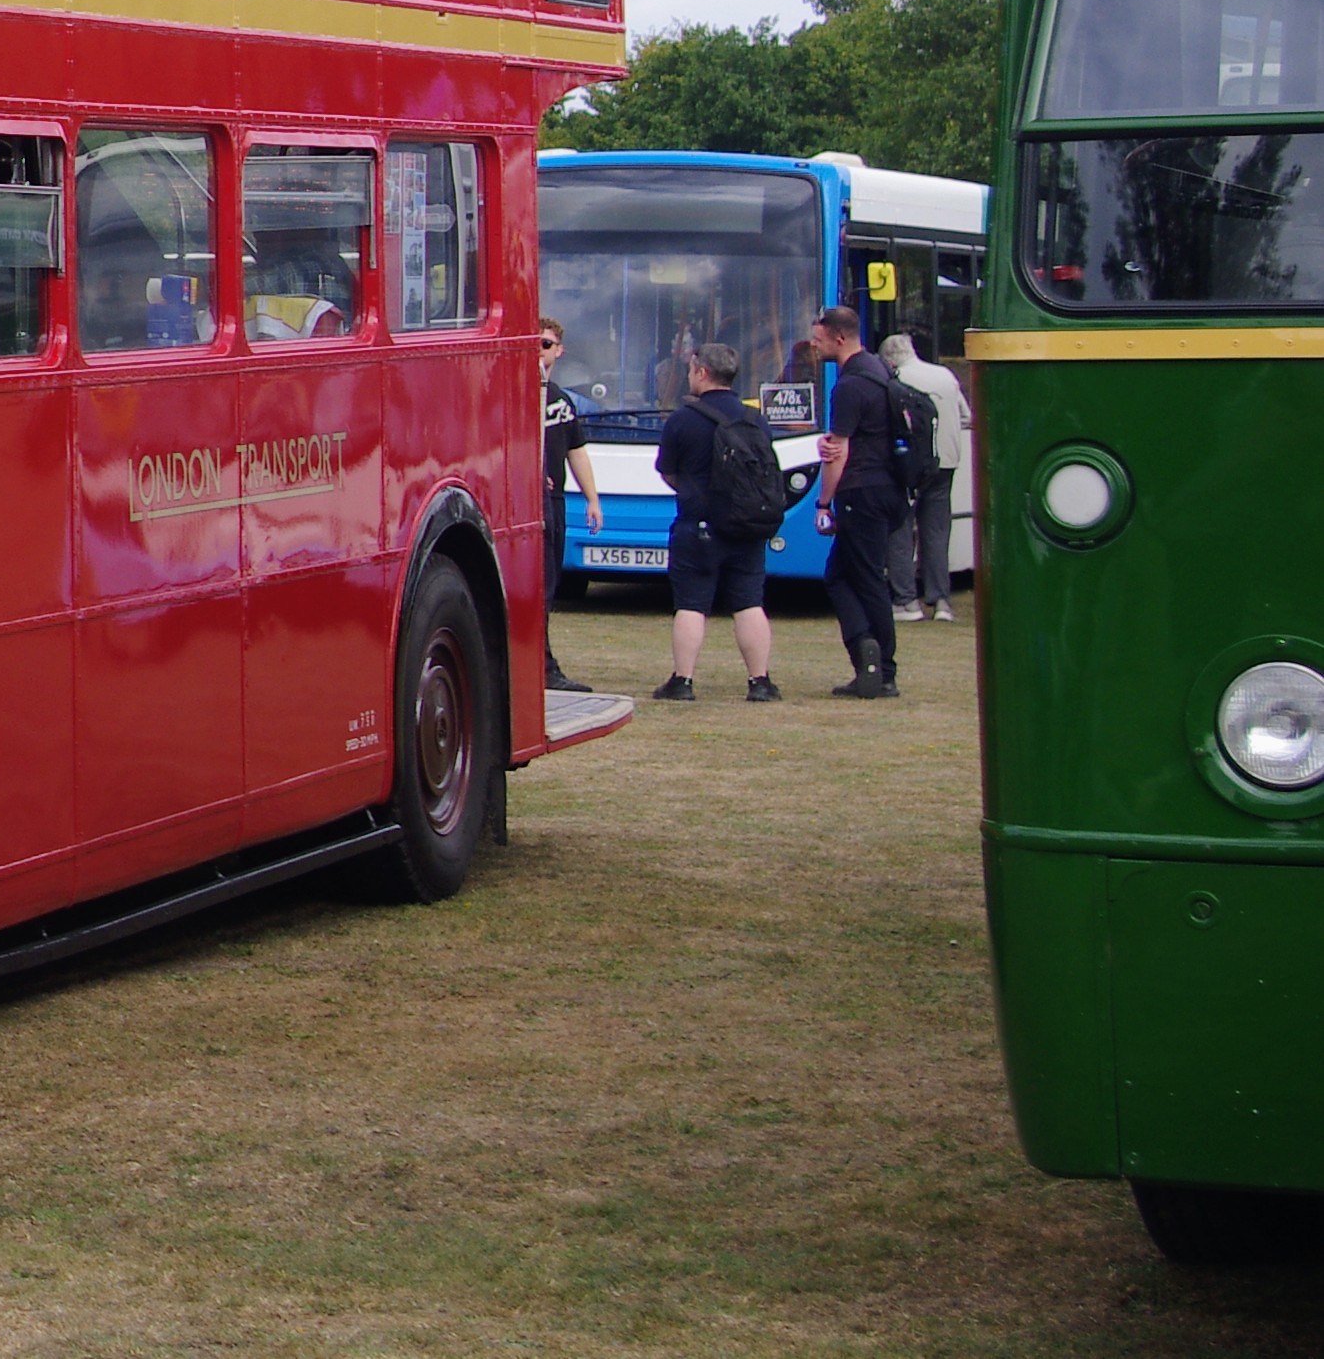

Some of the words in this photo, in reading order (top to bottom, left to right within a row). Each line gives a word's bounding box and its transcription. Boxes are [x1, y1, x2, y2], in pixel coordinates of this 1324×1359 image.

[766, 405, 809, 416] SWANLEY
[128, 448, 221, 522] LONDON
[236, 432, 347, 490] TRANSPORT
[590, 548, 631, 565] LX56
[634, 549, 664, 565] DZU
